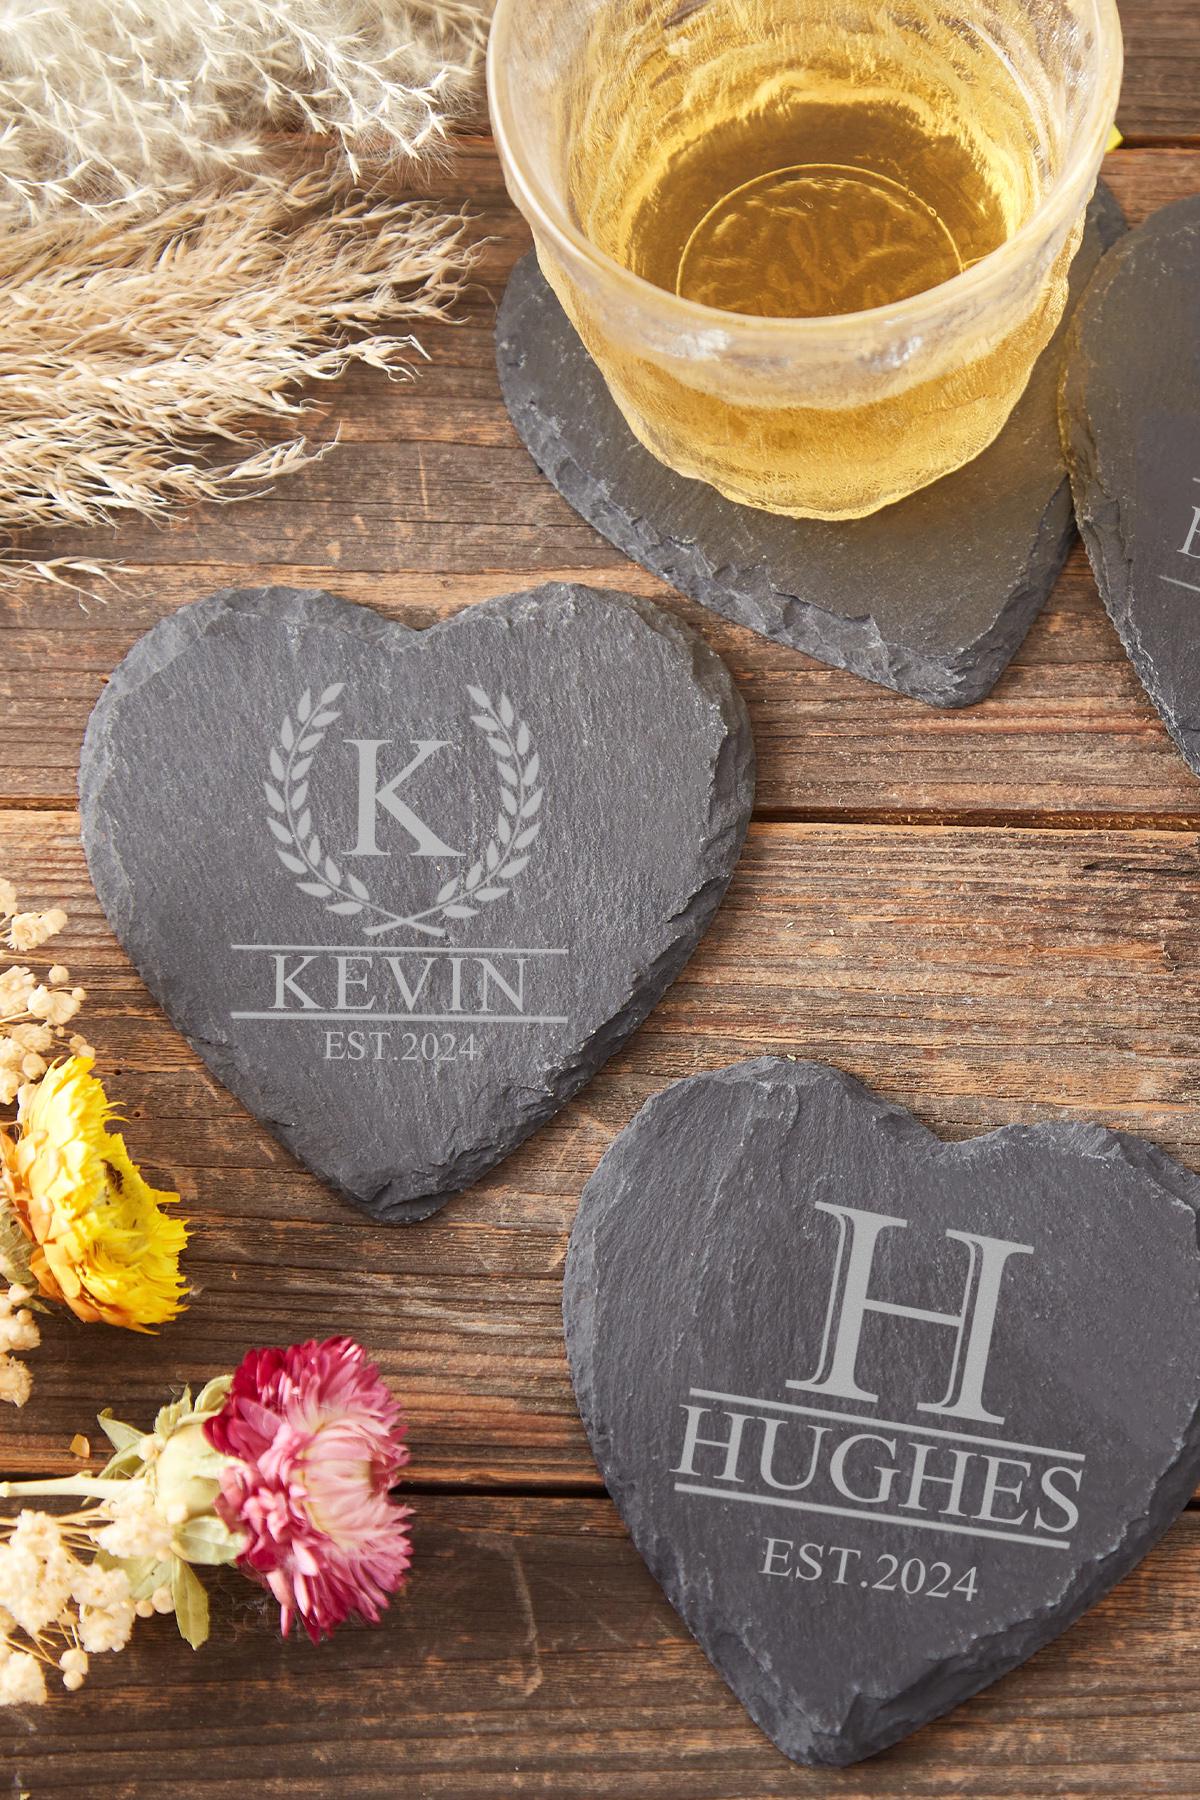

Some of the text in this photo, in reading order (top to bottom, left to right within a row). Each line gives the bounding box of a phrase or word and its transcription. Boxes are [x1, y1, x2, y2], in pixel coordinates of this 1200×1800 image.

[341, 738, 467, 857] K
[268, 953, 532, 1014] KEVIN
[322, 1030, 481, 1063] EST.2024
[785, 1199, 1035, 1425] H
[670, 1404, 1083, 1533] HUGHES
[760, 1538, 978, 1602] EST.2024
